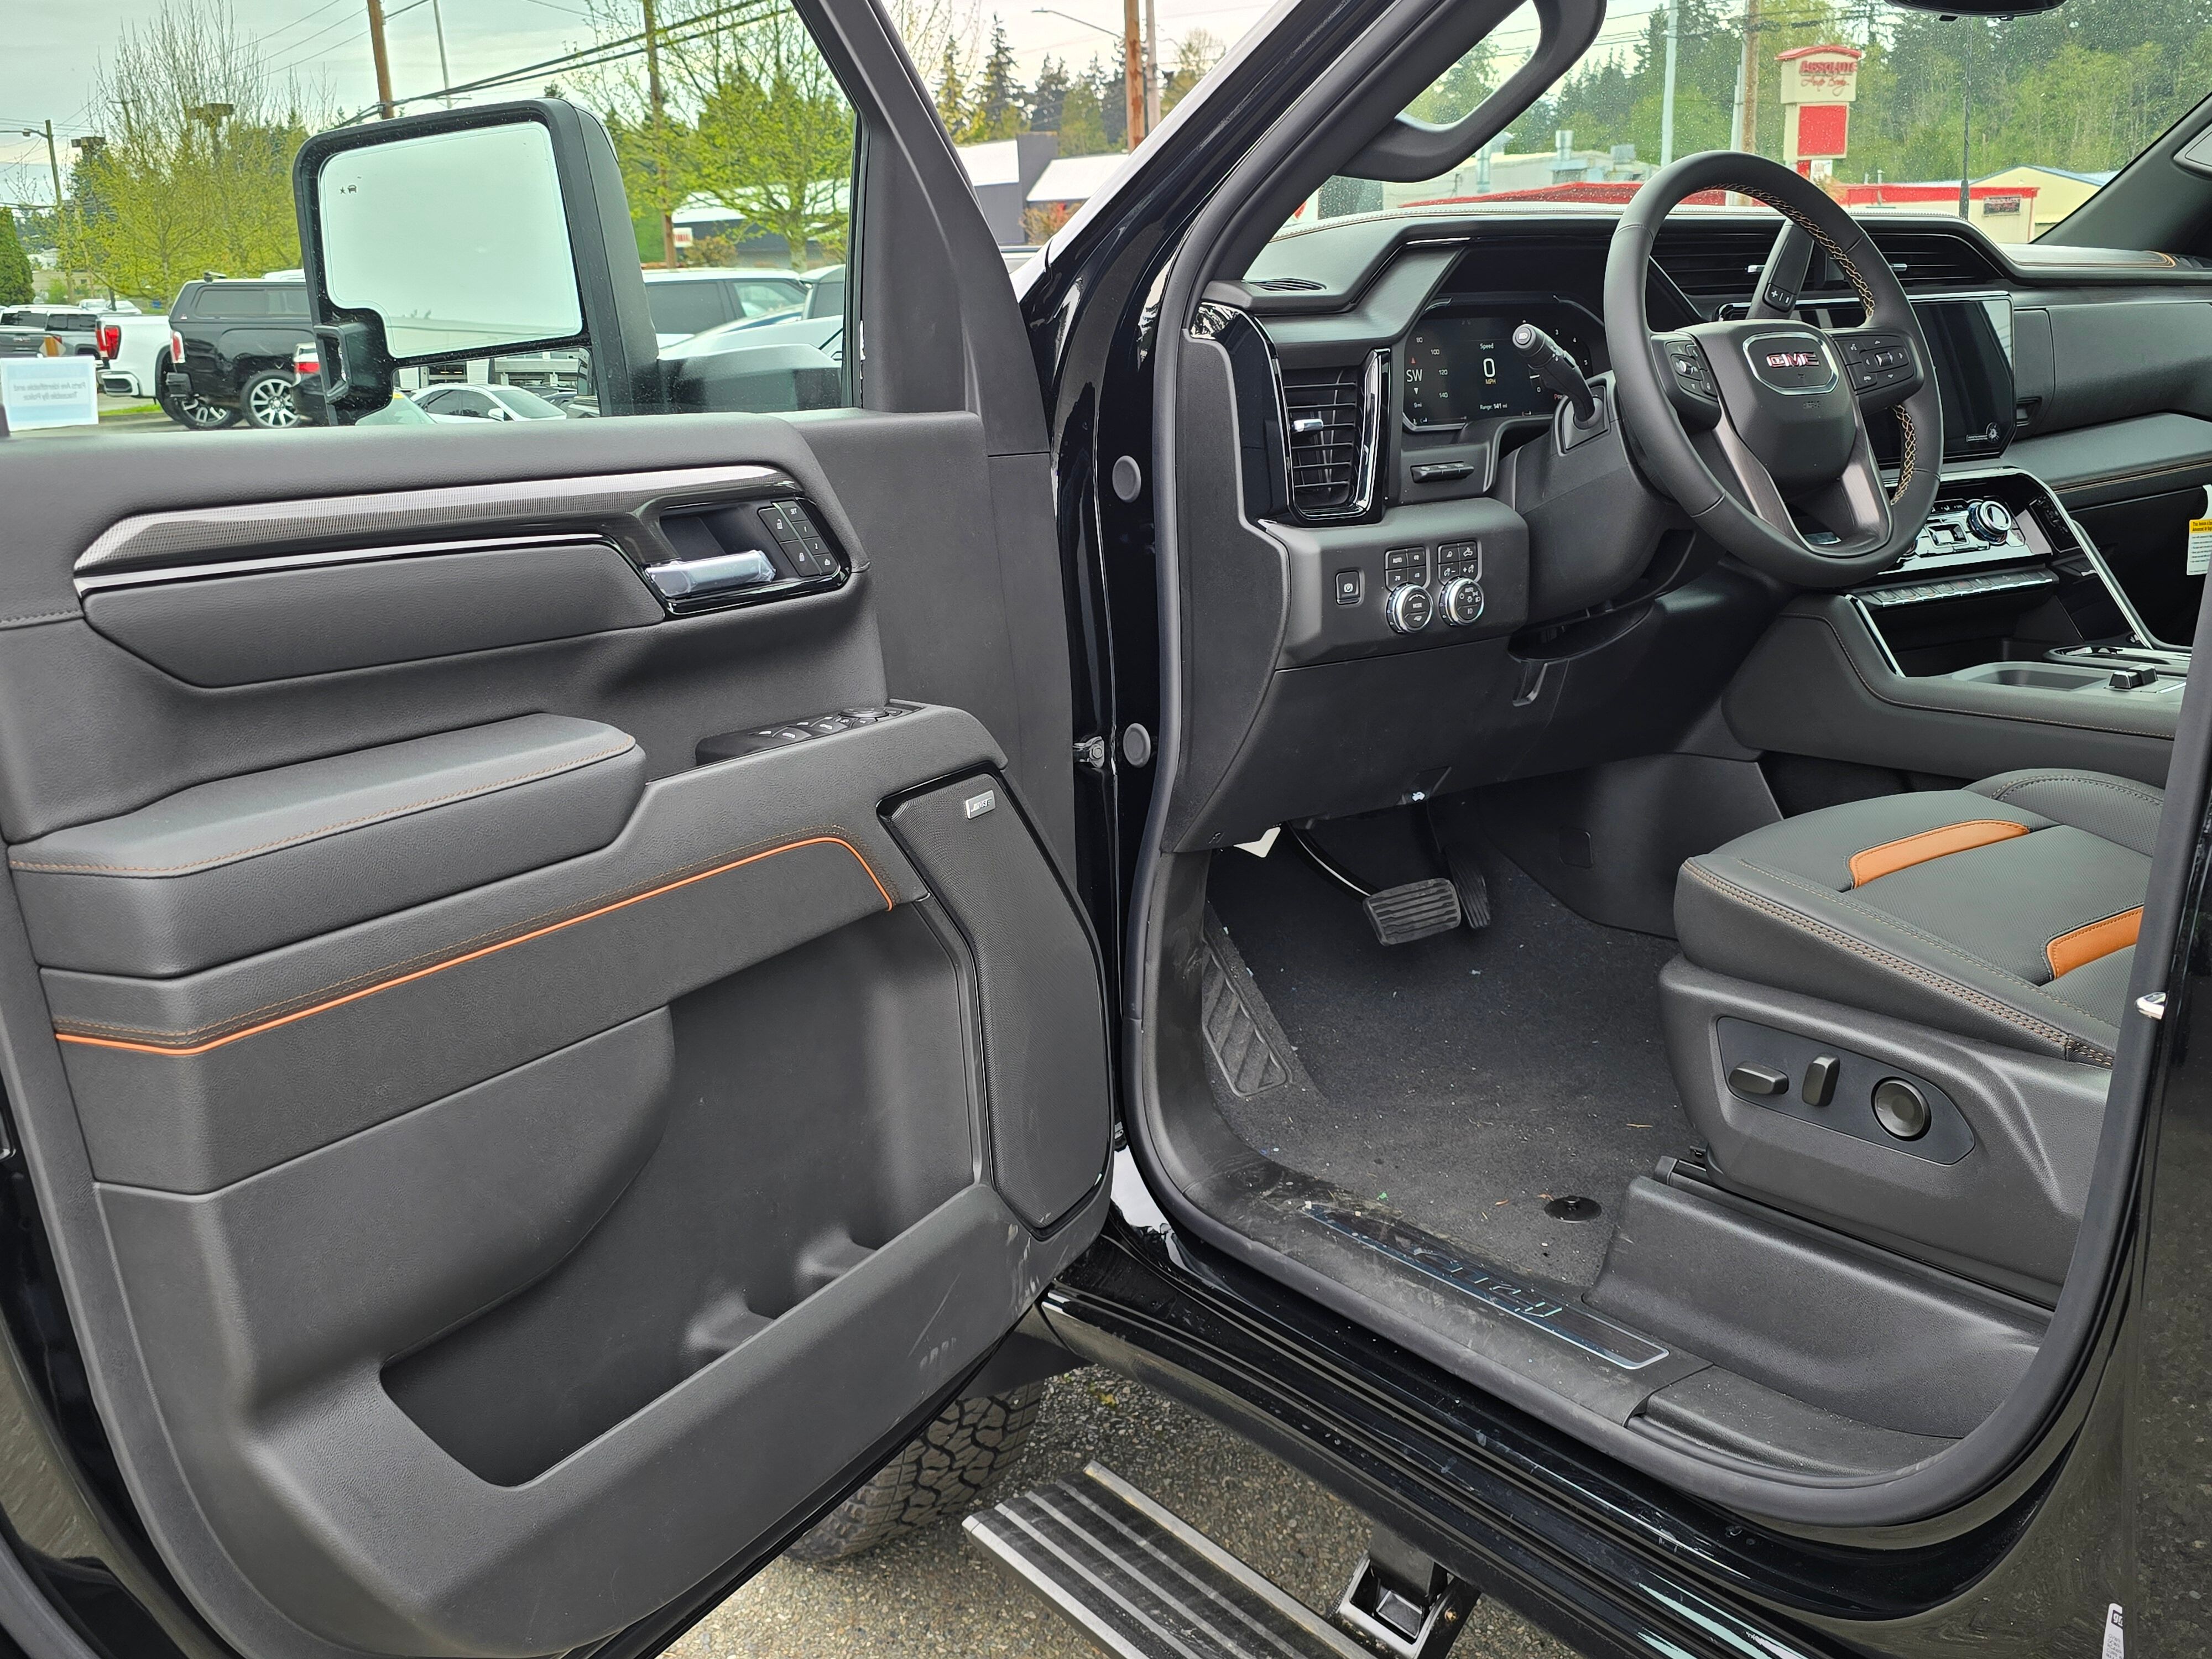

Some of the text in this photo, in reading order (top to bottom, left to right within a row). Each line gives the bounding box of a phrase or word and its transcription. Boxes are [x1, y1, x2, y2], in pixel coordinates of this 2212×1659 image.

[1766, 353, 1819, 367] GMC
[1483, 358, 1495, 378] 0
[1406, 369, 1423, 382] SW
[971, 797, 993, 812] BOSE
